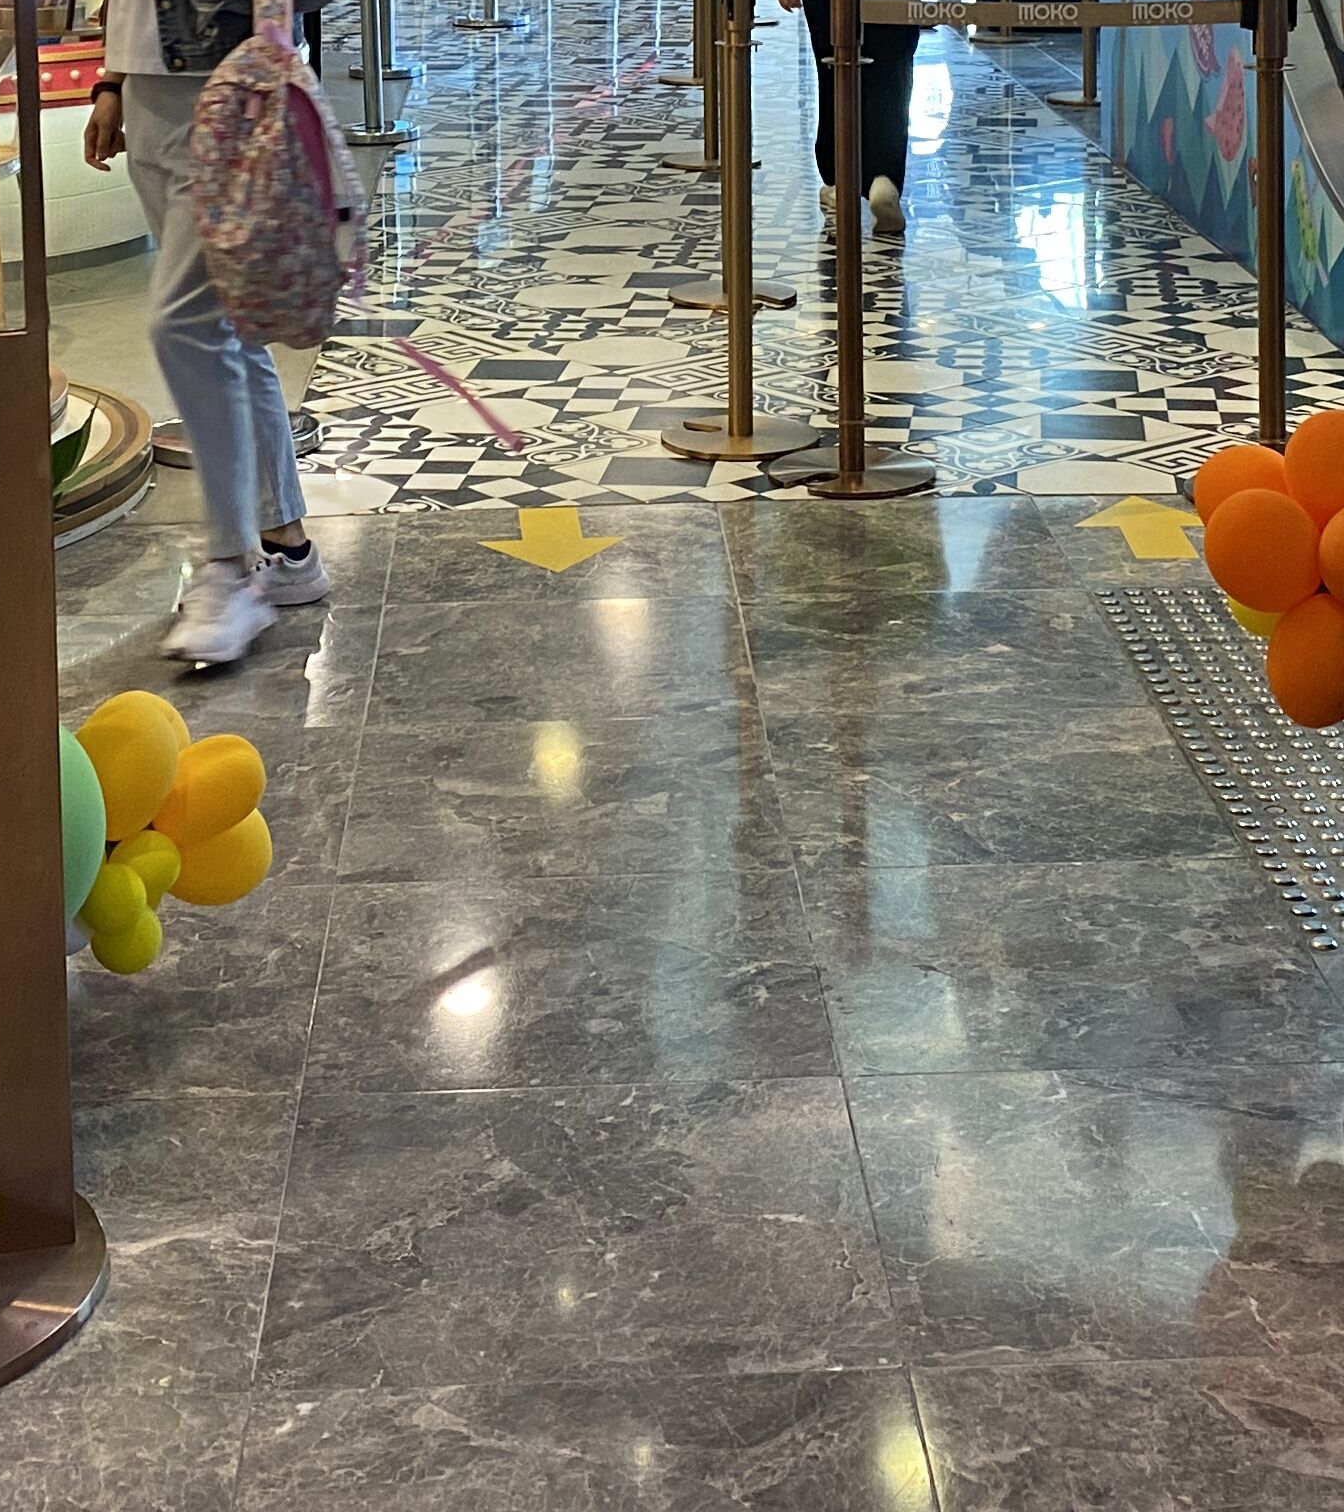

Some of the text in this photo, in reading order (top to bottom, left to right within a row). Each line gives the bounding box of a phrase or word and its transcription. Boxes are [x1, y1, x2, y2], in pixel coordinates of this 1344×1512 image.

[907, 1, 1194, 20] MOKO MOKO MOKO
